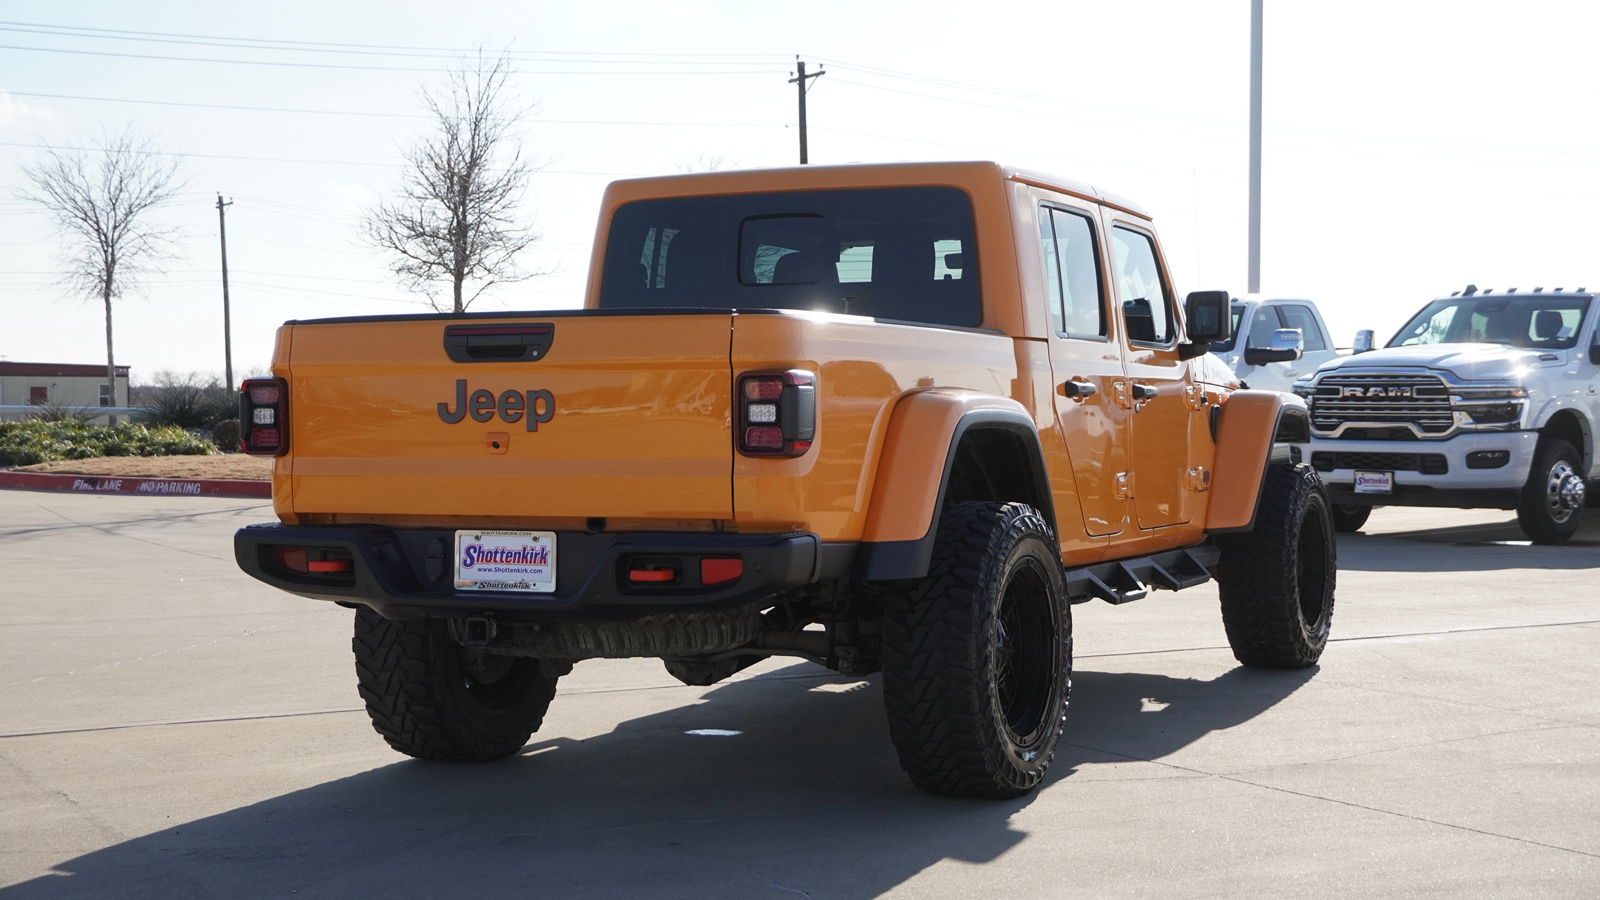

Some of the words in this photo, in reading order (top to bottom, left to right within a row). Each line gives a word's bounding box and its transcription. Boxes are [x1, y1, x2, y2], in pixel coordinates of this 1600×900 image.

[1343, 387, 1411, 397] RAM
[437, 379, 555, 432] Jeep
[95, 480, 122, 491] LANE
[139, 481, 155, 492] NO
[156, 482, 201, 494] PARKING
[462, 543, 551, 569] Shottenkirk
[477, 566, 543, 575] www.Shottenkirk.com
